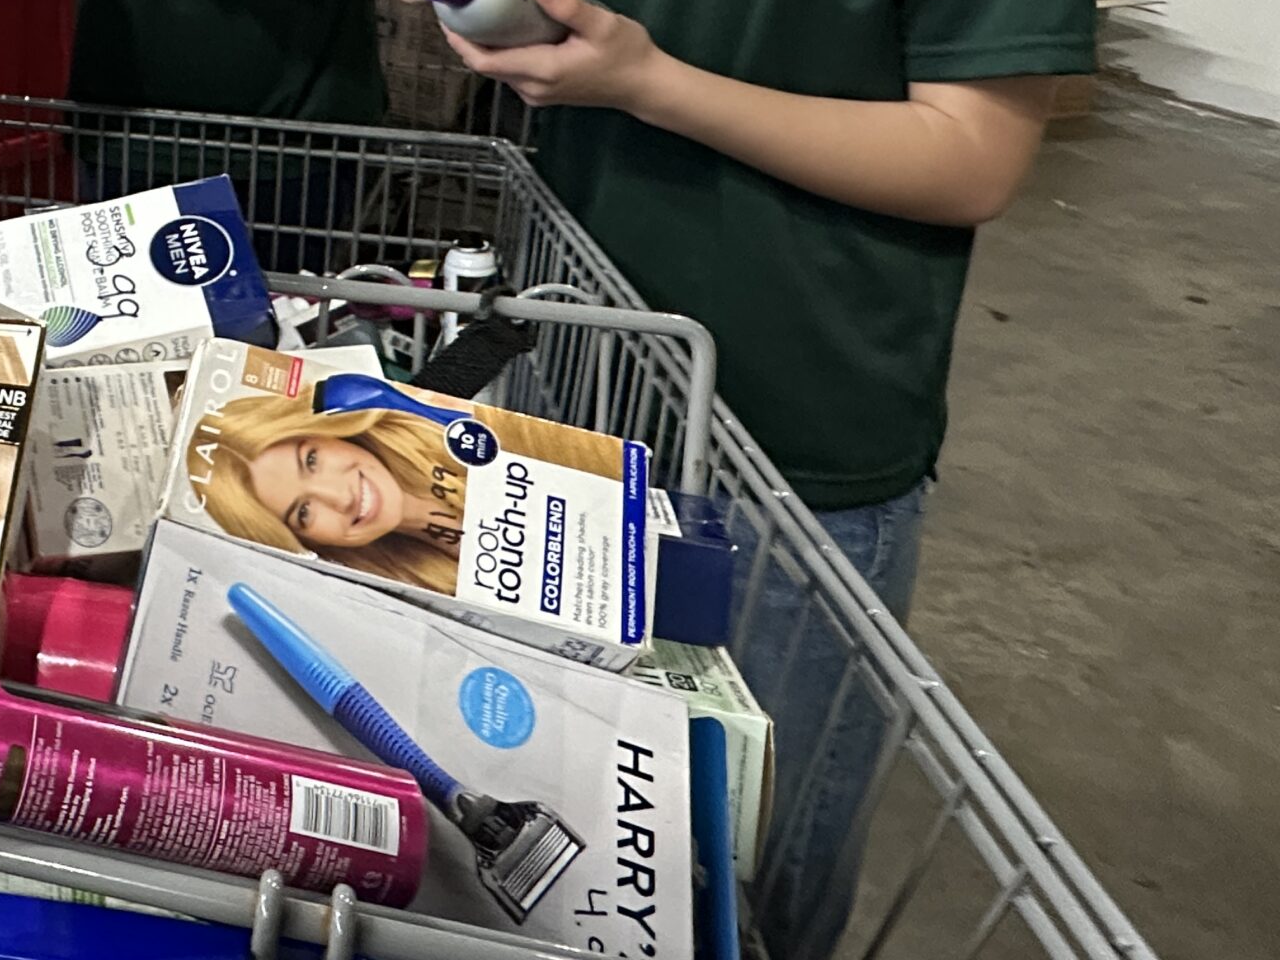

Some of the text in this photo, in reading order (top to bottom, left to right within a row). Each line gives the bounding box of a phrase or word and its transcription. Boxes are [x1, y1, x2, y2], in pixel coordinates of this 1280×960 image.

[165, 234, 189, 275] MEN
[180, 223, 210, 280] NIVEA
[245, 374, 258, 384] 8
[183, 348, 238, 514] CLAIROL
[461, 433, 475, 450] 10
[476, 433, 487, 459] mins
[474, 518, 501, 590] root
[495, 462, 535, 604] touch-up
[543, 499, 564, 611] COLORBLEND
[628, 565, 637, 587] ROOT
[179, 589, 196, 620] Razor
[572, 583, 583, 623] Matches
[627, 588, 637, 638] PERMANENT
[170, 622, 190, 662] Handle
[493, 685, 510, 733] Quality
[617, 739, 656, 959] HARRY'
